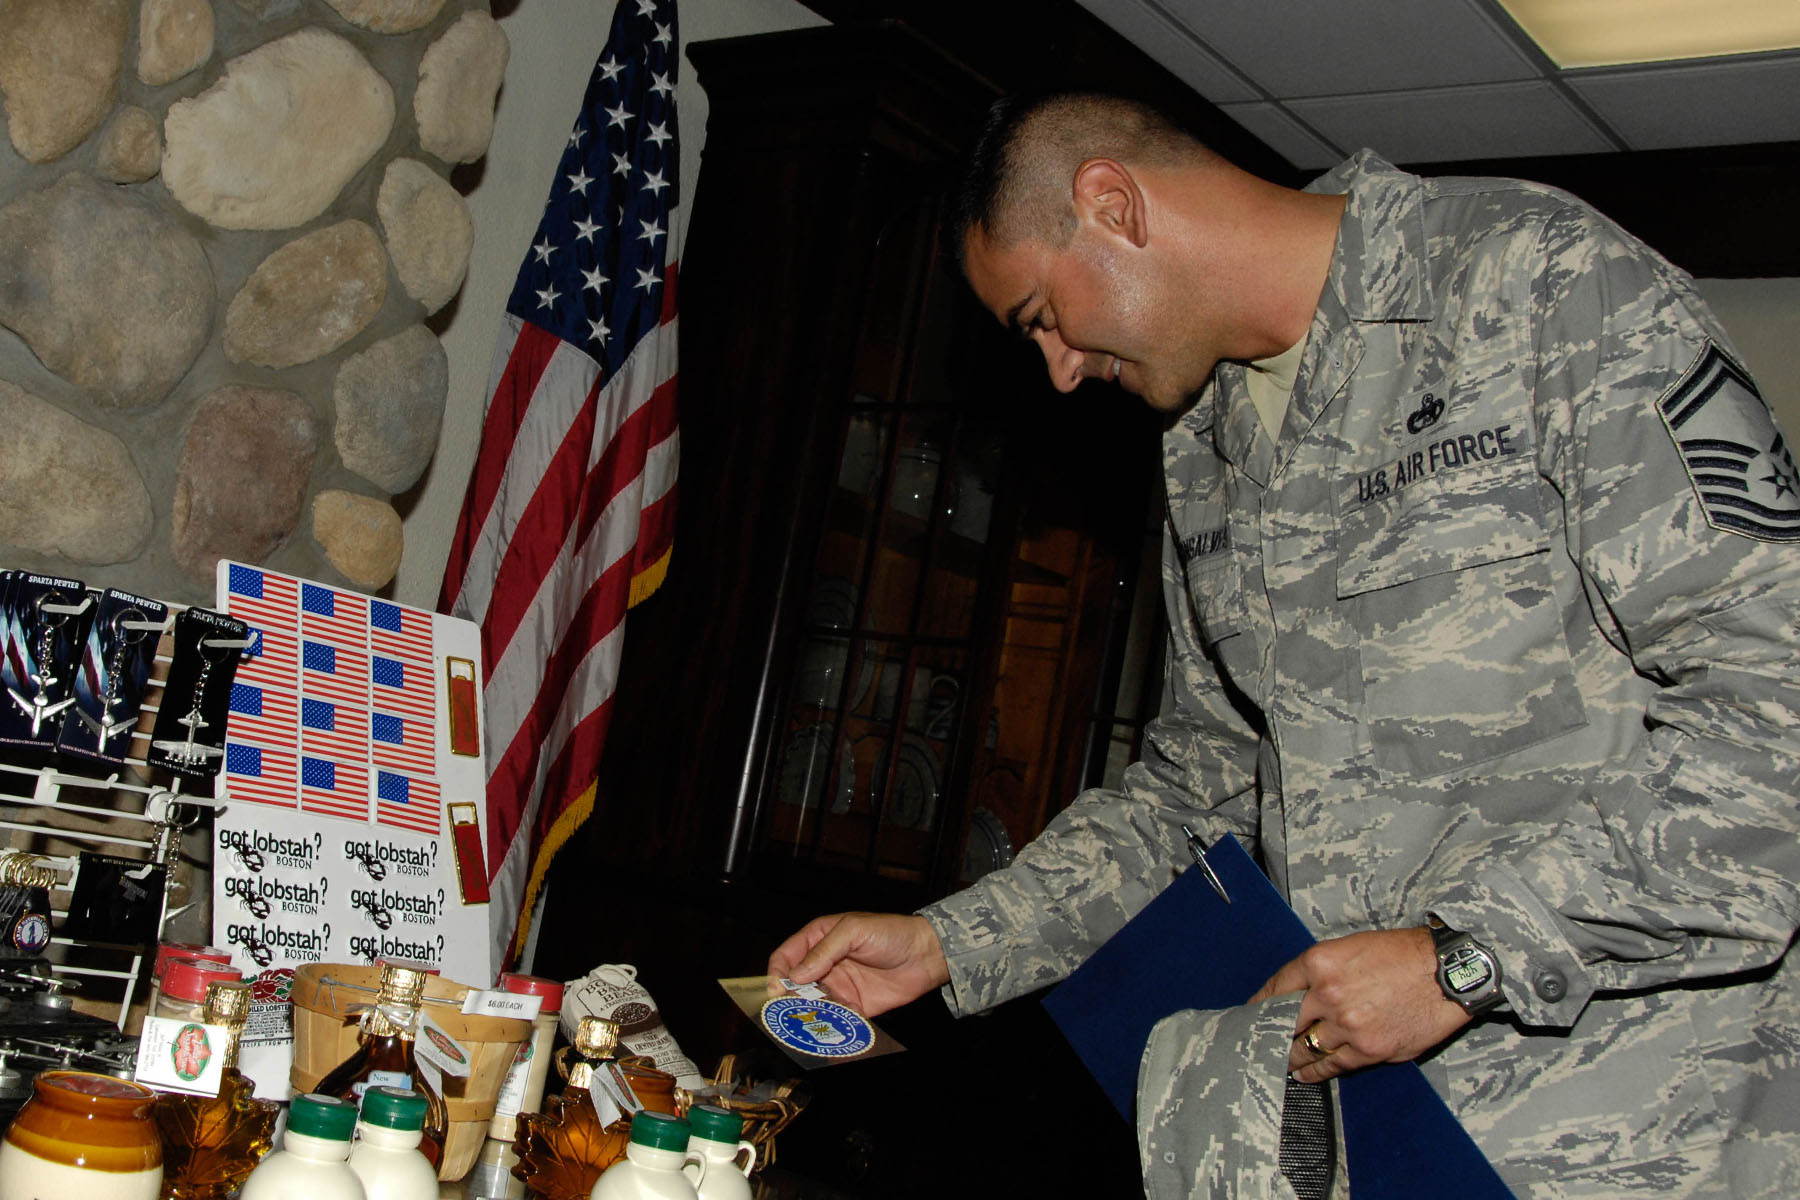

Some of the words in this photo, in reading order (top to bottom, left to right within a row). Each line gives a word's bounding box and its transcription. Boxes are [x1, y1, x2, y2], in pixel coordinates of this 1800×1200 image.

[1358, 470, 1390, 503] U.S.
[1394, 452, 1424, 489] AIR
[1429, 425, 1516, 473] FORCE
[28, 575, 53, 586] SPARTA
[53, 578, 80, 590] PEWTER
[110, 590, 135, 603] SPARTA
[135, 597, 162, 611] PEWTER
[219, 829, 249, 849] got
[253, 829, 322, 860] lobstah?
[344, 840, 371, 860] got
[375, 840, 438, 868] lobstah?
[276, 855, 312, 870] BOSTON
[397, 864, 430, 877] BOSTON
[224, 876, 254, 898] got
[258, 875, 328, 905] lobstah?
[282, 901, 318, 915] BOSTON
[351, 889, 378, 909] got
[381, 888, 445, 916] lobstah?
[403, 912, 436, 925] BOSTON
[227, 923, 257, 945] got
[261, 922, 331, 951] lobstah?
[285, 948, 321, 962] BOSTON
[350, 935, 377, 956] got
[381, 934, 444, 962] lobstah?
[488, 999, 506, 1009] $6.00
[505, 1001, 524, 1010] EACH
[770, 999, 803, 1015] STATES
[805, 999, 826, 1009] AIR
[828, 1003, 863, 1027] FORCE
[766, 1011, 789, 1041] UNITED
[816, 1040, 866, 1055] RETIRED
[373, 1073, 389, 1082] New
